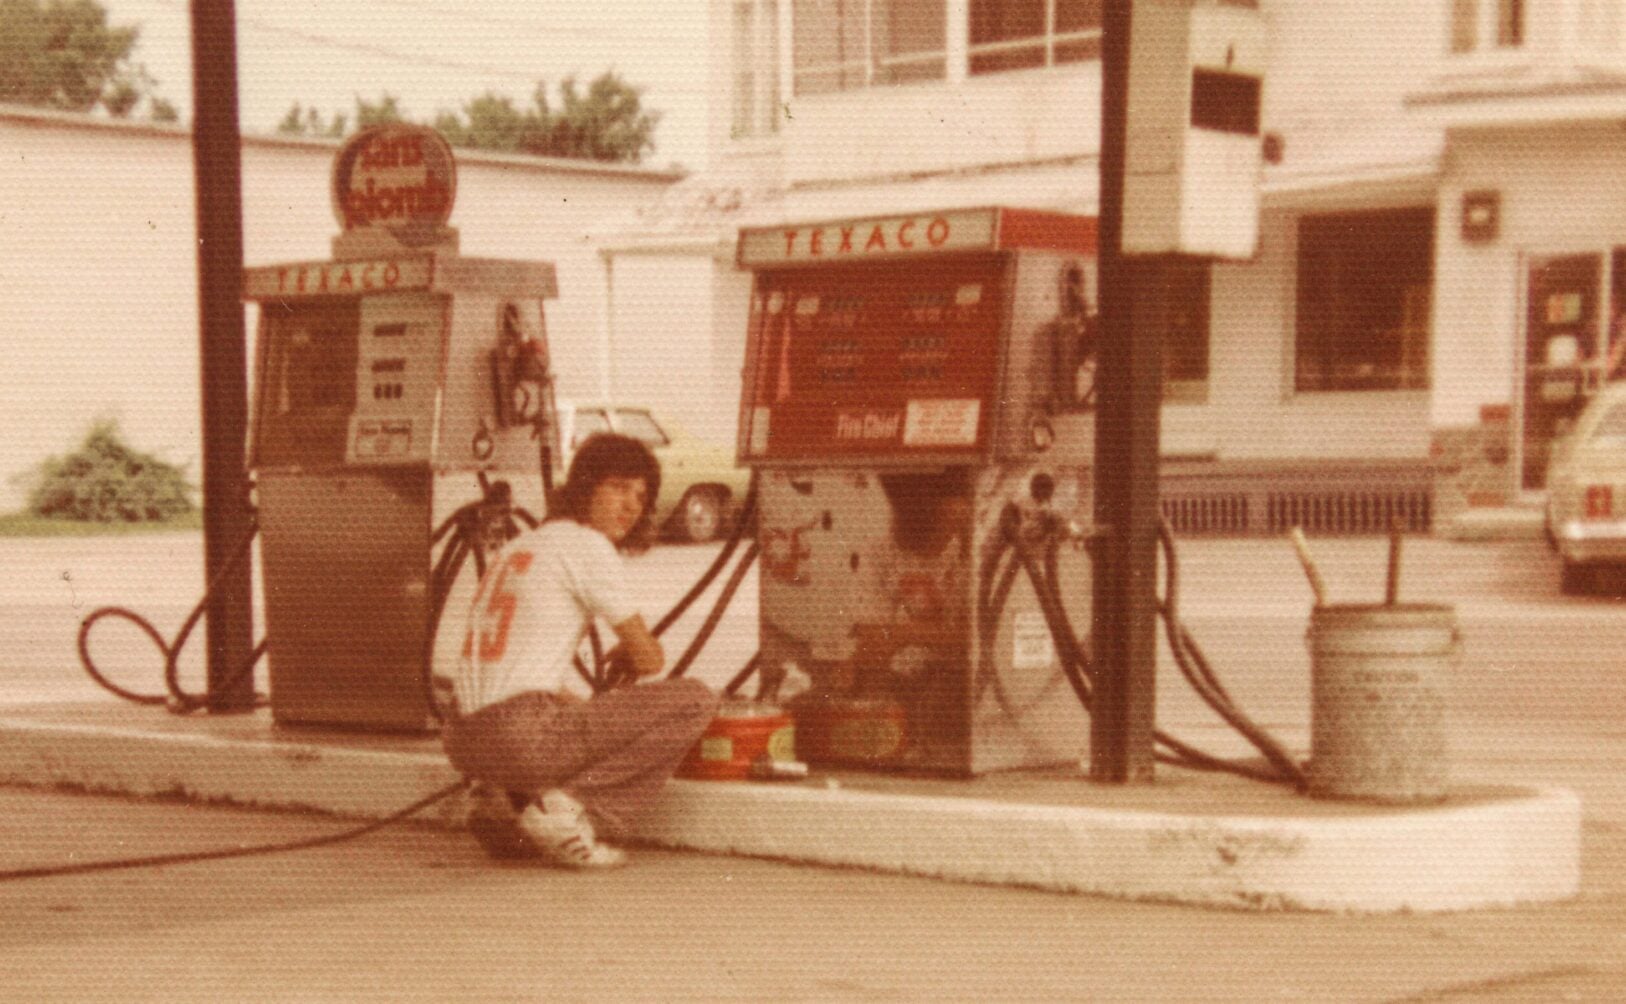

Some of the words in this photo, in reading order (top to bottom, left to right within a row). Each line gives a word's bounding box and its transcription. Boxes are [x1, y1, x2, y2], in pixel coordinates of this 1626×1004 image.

[347, 170, 450, 229] plomb
[784, 217, 949, 257] TEXACO
[277, 260, 399, 293] TEXACO
